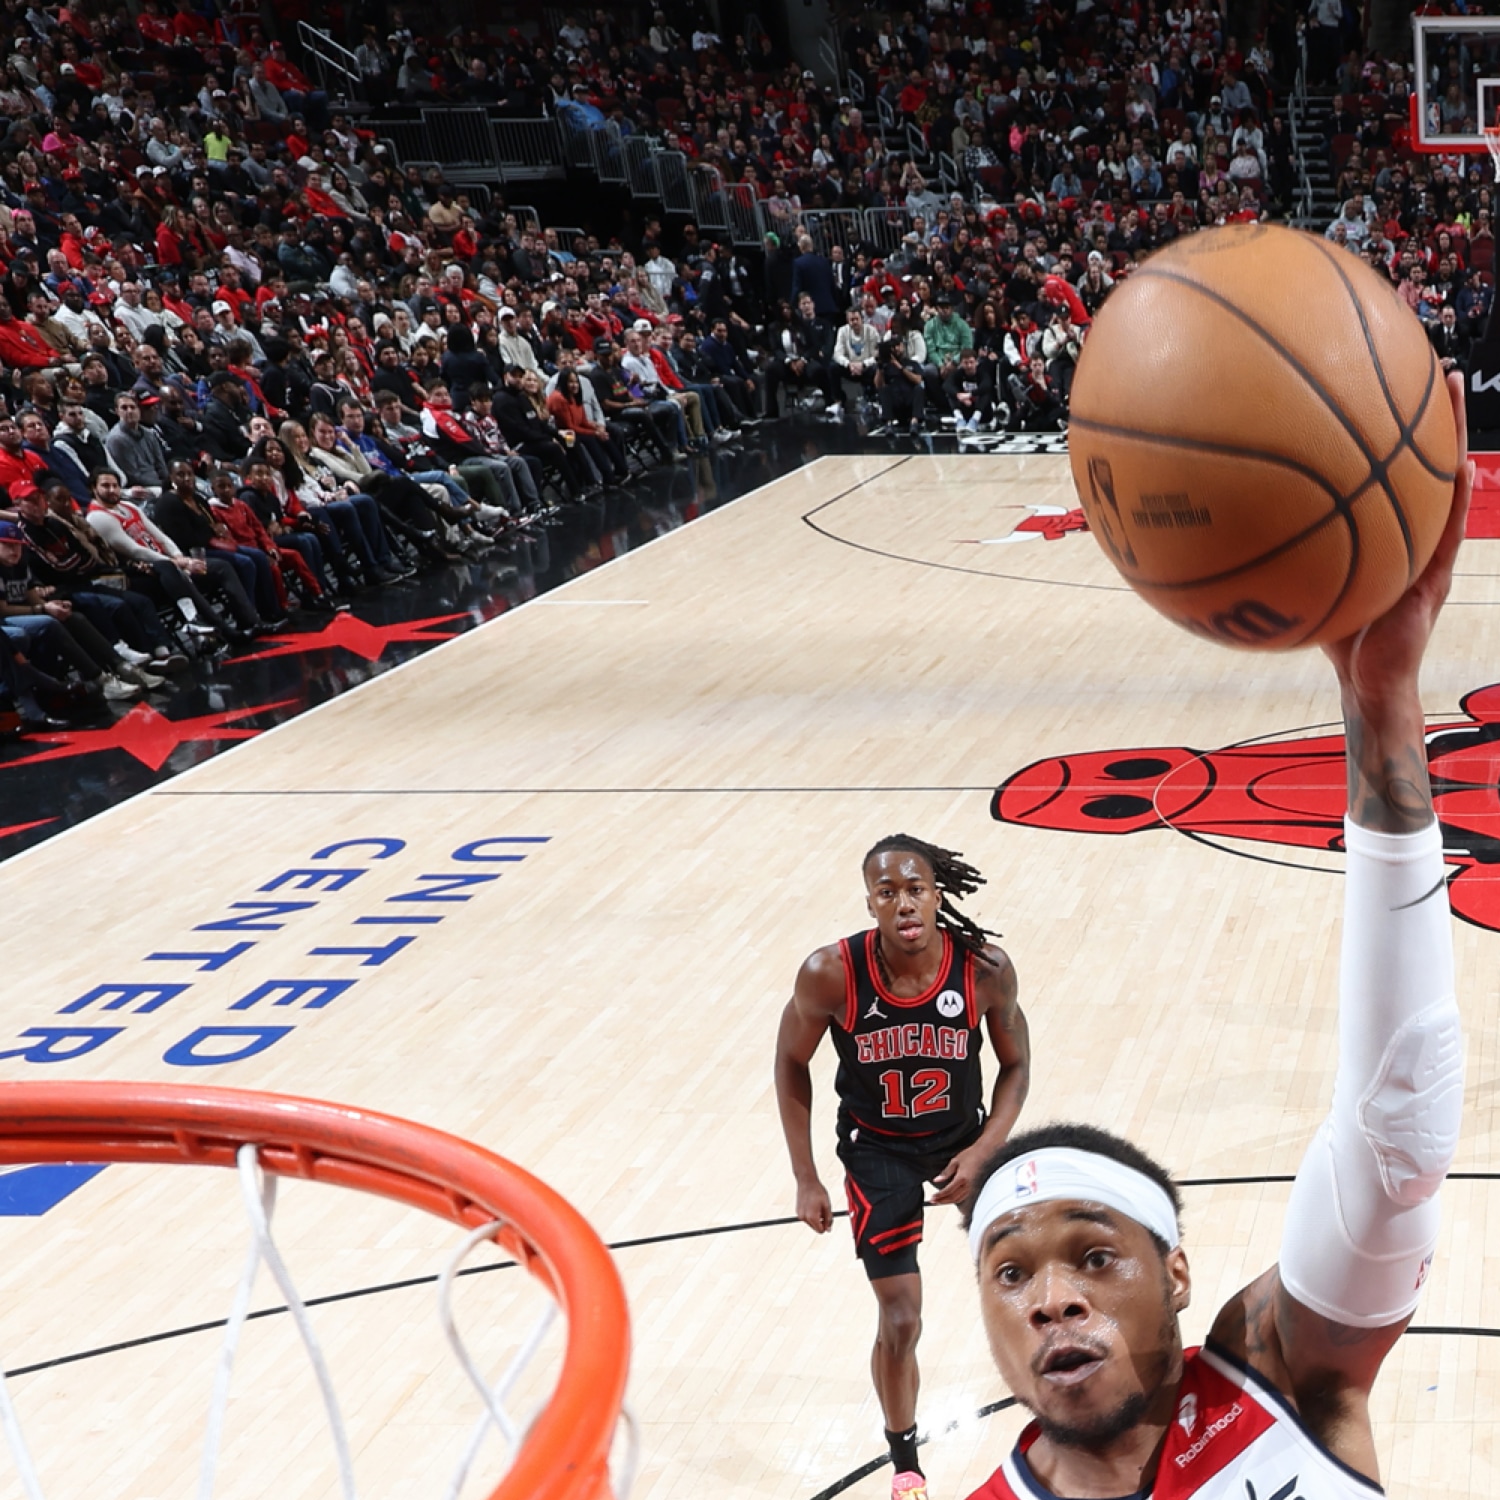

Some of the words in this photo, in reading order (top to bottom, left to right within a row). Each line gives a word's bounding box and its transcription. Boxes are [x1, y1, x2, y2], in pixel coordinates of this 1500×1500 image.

[0, 836, 407, 1063] CENTER
[162, 836, 553, 1067] UNITED
[855, 1022, 969, 1064] CHICAGO
[880, 1068, 950, 1118] 12
[1175, 1402, 1243, 1468] Robinhood
